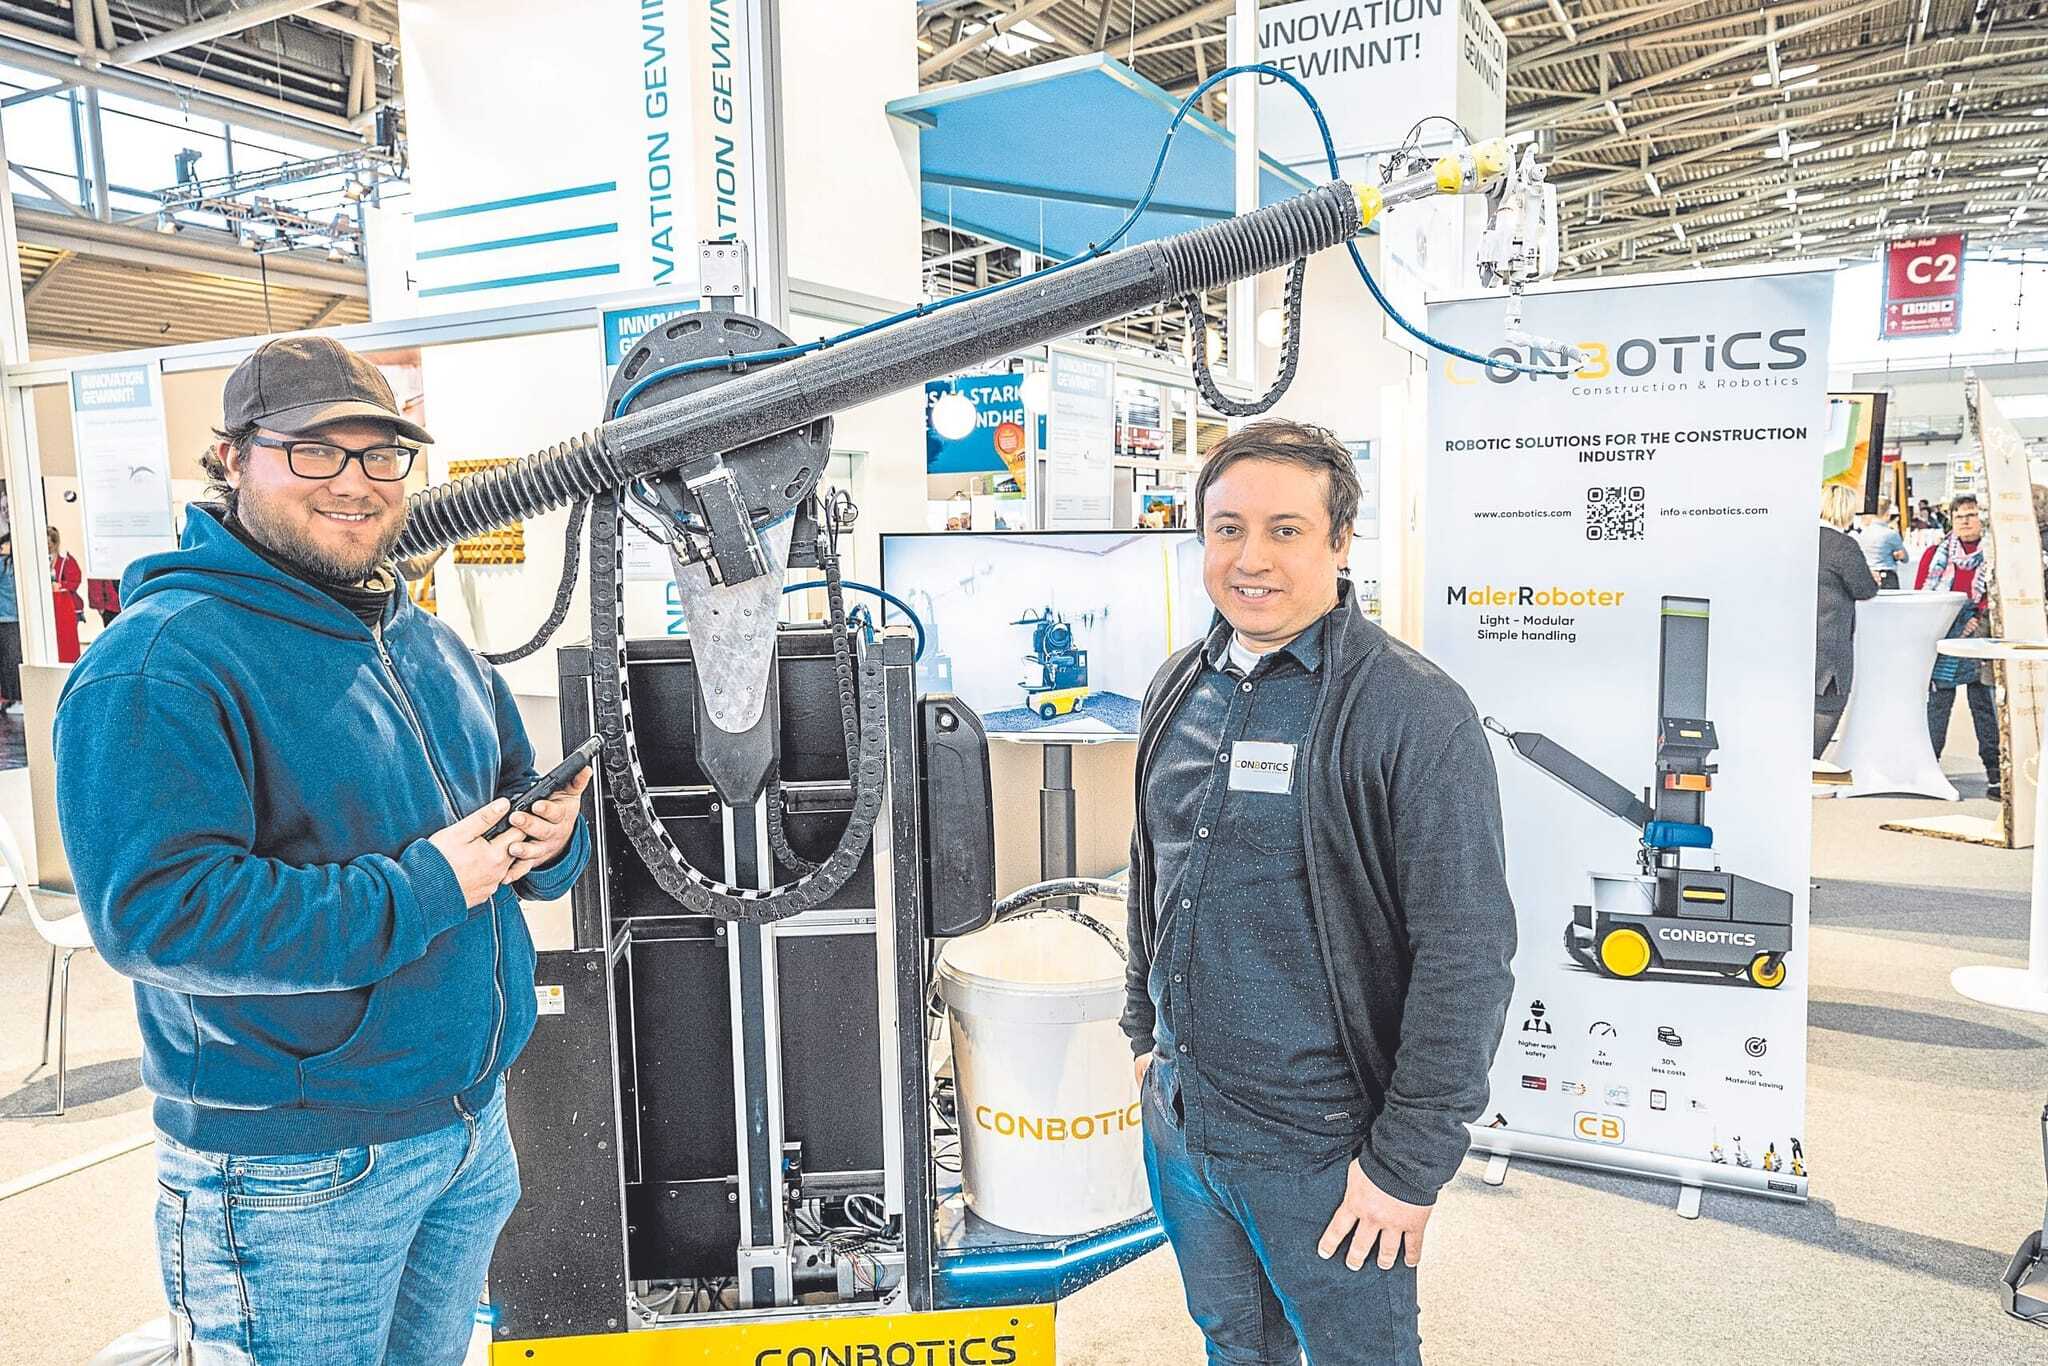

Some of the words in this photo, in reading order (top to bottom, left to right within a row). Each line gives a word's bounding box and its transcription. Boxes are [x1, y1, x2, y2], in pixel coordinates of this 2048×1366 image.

[647, 131, 675, 286] VATION
[1906, 253, 1957, 285] C2
[1571, 380, 1688, 397] Construction
[1697, 380, 1707, 391] &
[1716, 376, 1800, 390] Robotics
[1445, 438, 1511, 452] ROBOTIC
[1515, 434, 1601, 450] SOLUTIONS
[1605, 433, 1637, 446] FOR
[1640, 431, 1671, 445] THE
[1674, 426, 1808, 444] CONSTRUCTION
[1578, 448, 1657, 464] INDUSTRY
[1474, 508, 1572, 519] www.conbotics.com
[1447, 585, 1625, 607] MalerRoboter
[1480, 615, 1510, 627] Light
[1523, 615, 1575, 626] Modular
[1477, 629, 1518, 642] Simple
[1521, 629, 1576, 643] handling
[1659, 927, 1756, 947] CONBOTICS
[1518, 1040, 1539, 1049] higher
[1651, 1066, 1665, 1074] less
[1667, 1069, 1686, 1077] costs
[1725, 1076, 1756, 1086] Material
[1758, 1080, 1783, 1091] saving
